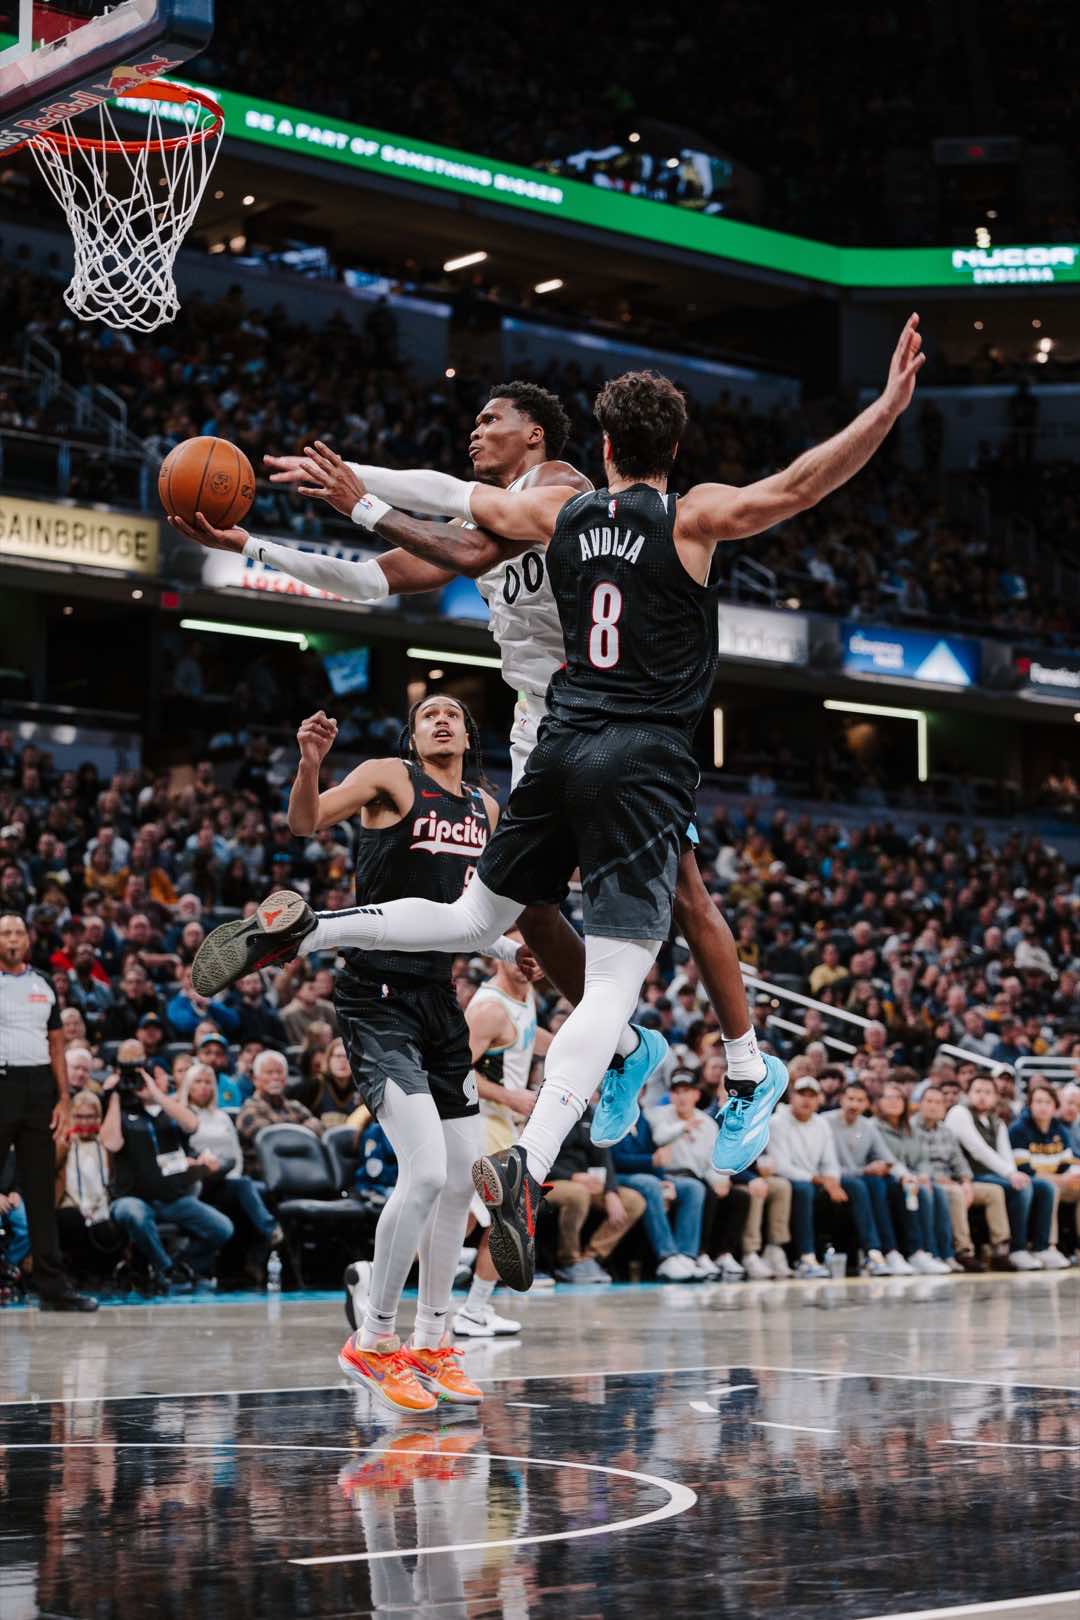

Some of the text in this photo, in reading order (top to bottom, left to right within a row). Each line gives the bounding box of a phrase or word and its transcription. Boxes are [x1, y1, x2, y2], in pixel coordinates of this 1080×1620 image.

[245, 110, 563, 205] BE A PART OF SOMETHING BIGGER
[952, 247, 1076, 268] NUCOR
[578, 526, 646, 565] AVDIJA
[503, 551, 545, 605] 00
[588, 580, 624, 670] 8
[410, 809, 488, 857] ripcity
